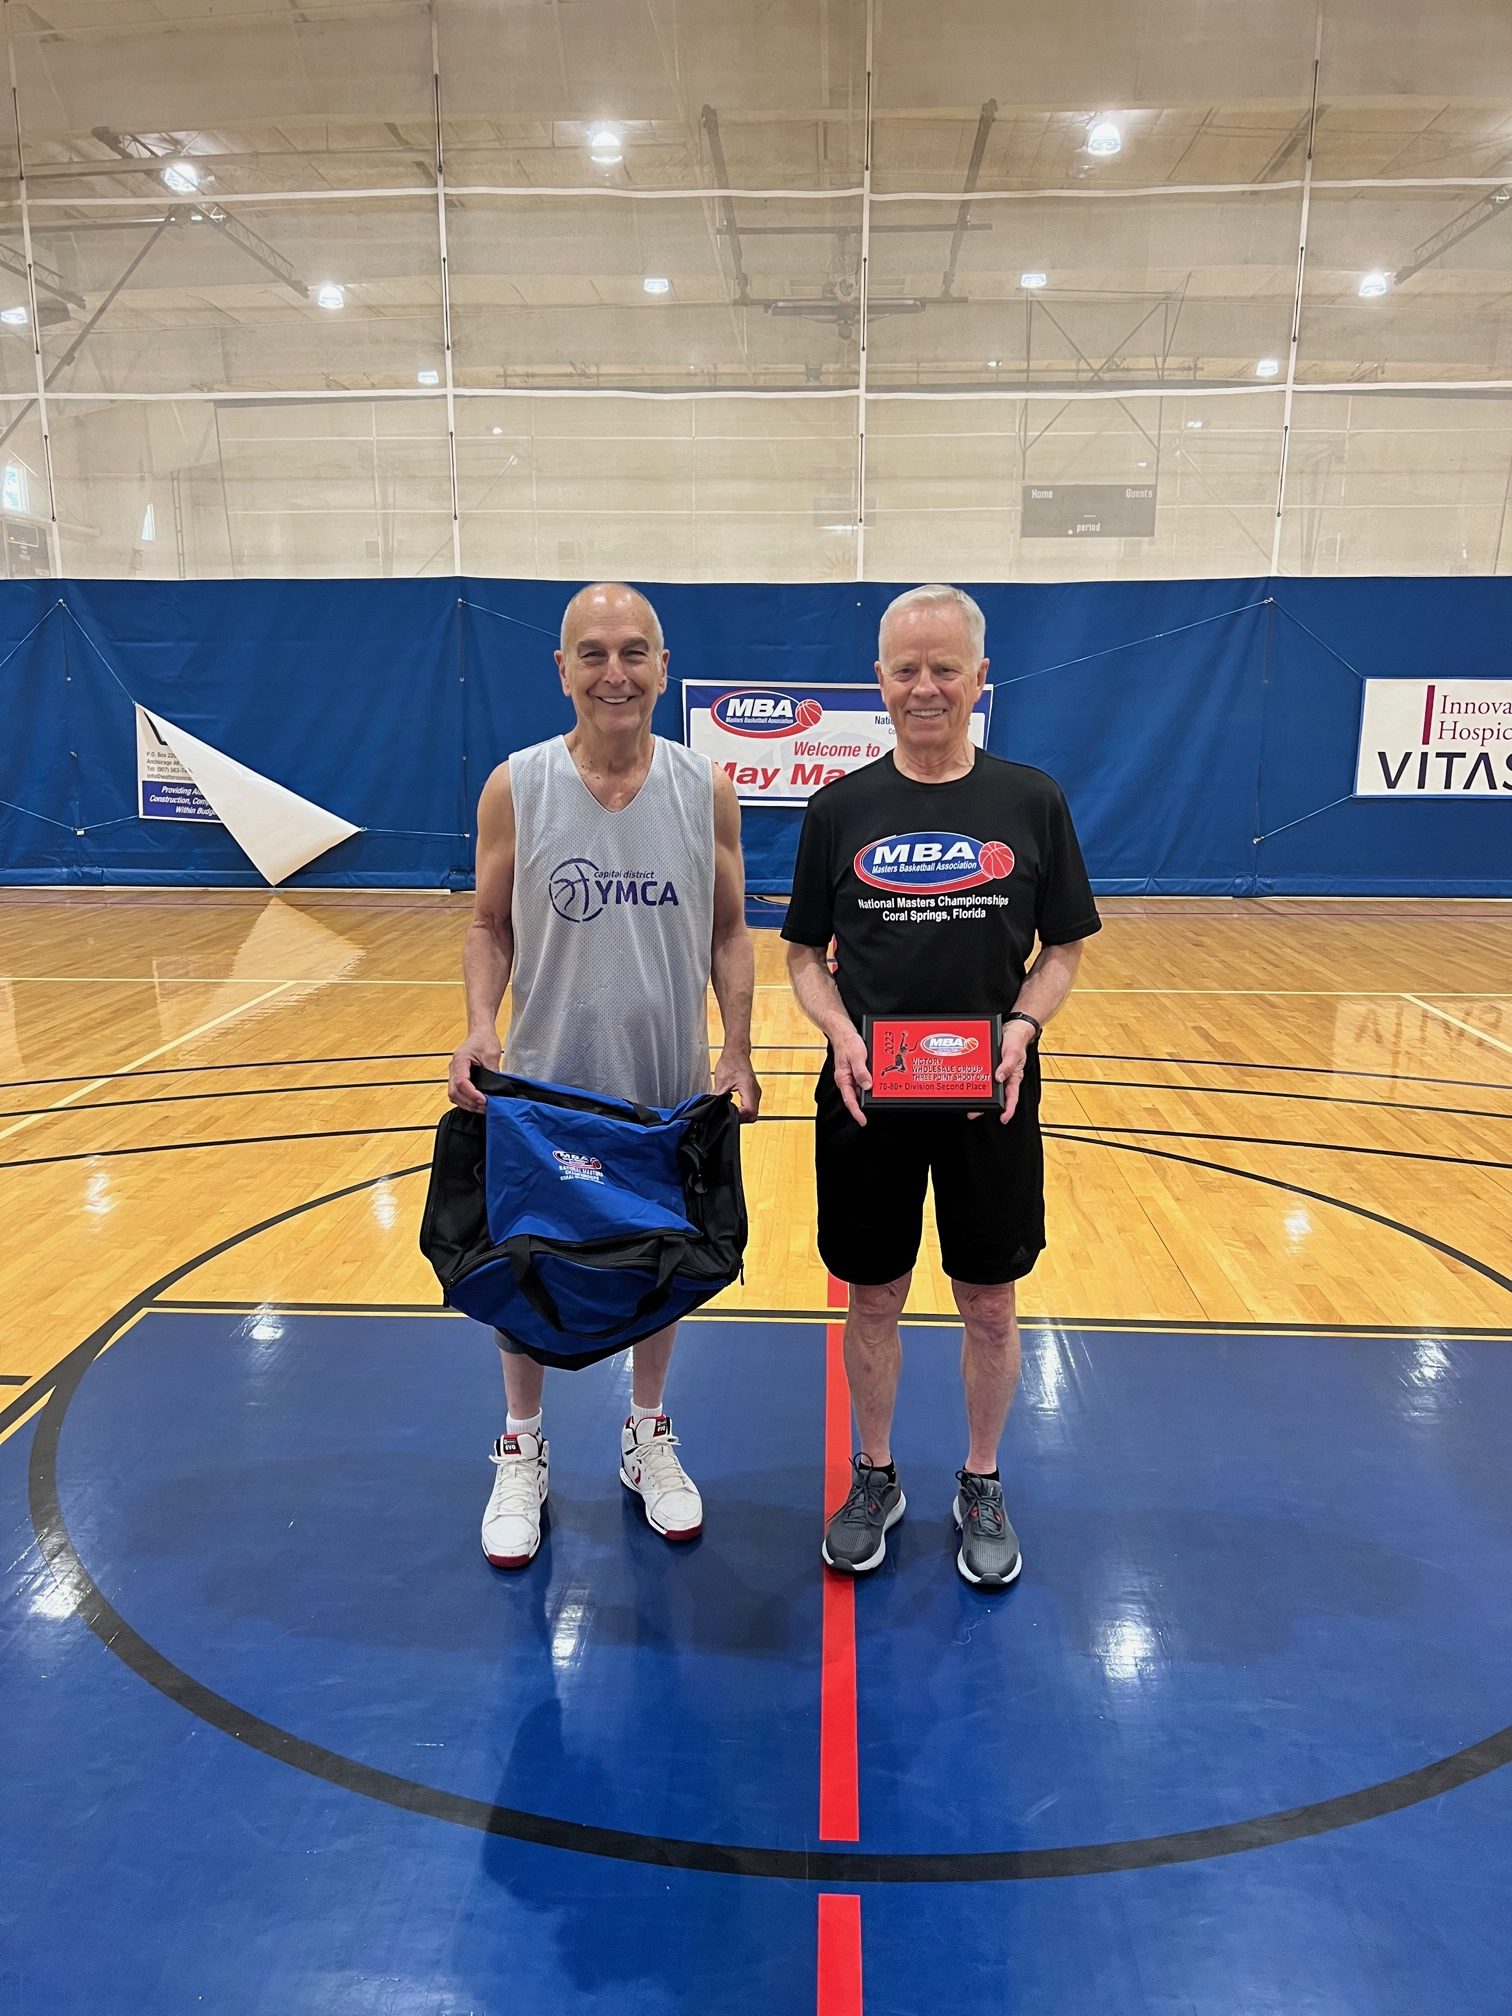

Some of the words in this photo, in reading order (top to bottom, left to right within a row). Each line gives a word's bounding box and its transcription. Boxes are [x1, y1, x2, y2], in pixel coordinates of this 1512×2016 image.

[1031, 489, 1053, 499] Home
[1076, 522, 1101, 533] period
[726, 699, 793, 717] MBA
[1440, 695, 1512, 715] Innova
[1437, 720, 1512, 746] Hospic
[794, 741, 861, 757] Welcome
[866, 745, 880, 757] to
[161, 786, 191, 796] Providing
[150, 795, 191, 805] Construction,
[176, 806, 195, 814] Within
[873, 841, 976, 865] MBA
[872, 864, 898, 874] Masters
[899, 862, 935, 873] Basketball
[936, 861, 977, 871] Association
[594, 870, 622, 879] capital
[623, 870, 655, 879] district
[594, 880, 679, 906] YMCA
[858, 898, 894, 910] National
[897, 896, 935, 908] Masters
[937, 894, 1009, 908] Championships
[882, 910, 908, 921] Coral
[910, 909, 951, 923] Springs,
[952, 907, 986, 919] Florida
[885, 1031, 895, 1054] 2023
[929, 1038, 963, 1047] MBA
[912, 1065, 956, 1073] WHOLESALE
[956, 1065, 983, 1073] GROUP
[912, 1073, 932, 1081] THREE
[933, 1073, 952, 1081] POINT
[954, 1073, 975, 1081] SHOOT
[977, 1073, 990, 1081] OUT
[904, 1082, 934, 1090] Division
[936, 1082, 964, 1090] Second
[966, 1082, 987, 1090] Place
